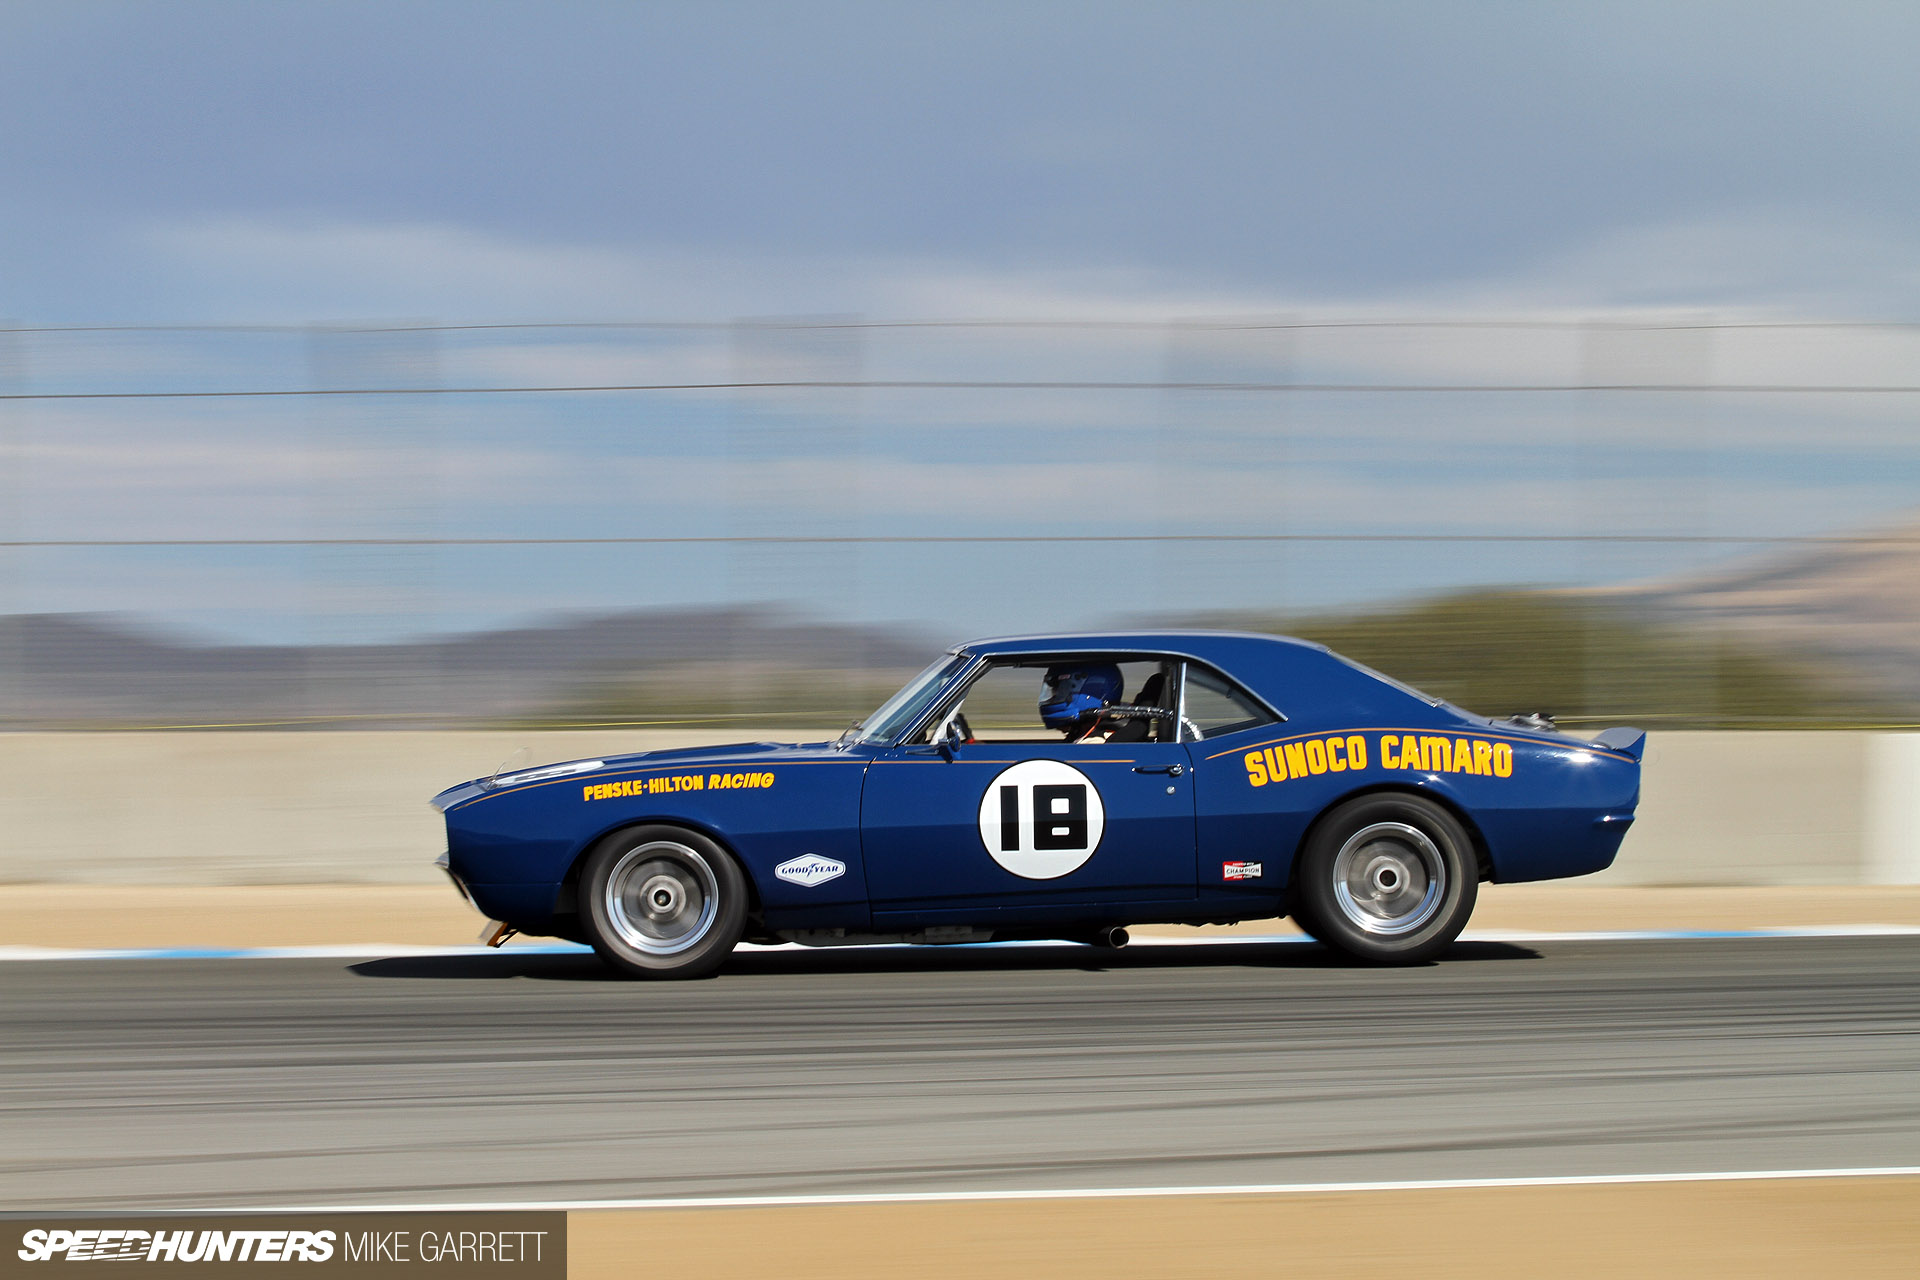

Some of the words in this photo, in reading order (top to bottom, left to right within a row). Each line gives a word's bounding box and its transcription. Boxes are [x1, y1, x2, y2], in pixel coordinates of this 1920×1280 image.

[1244, 735, 1368, 788] SUNOCO
[708, 772, 775, 790] RACING
[1000, 783, 1088, 852] 18
[781, 865, 839, 875] GOODYEAR
